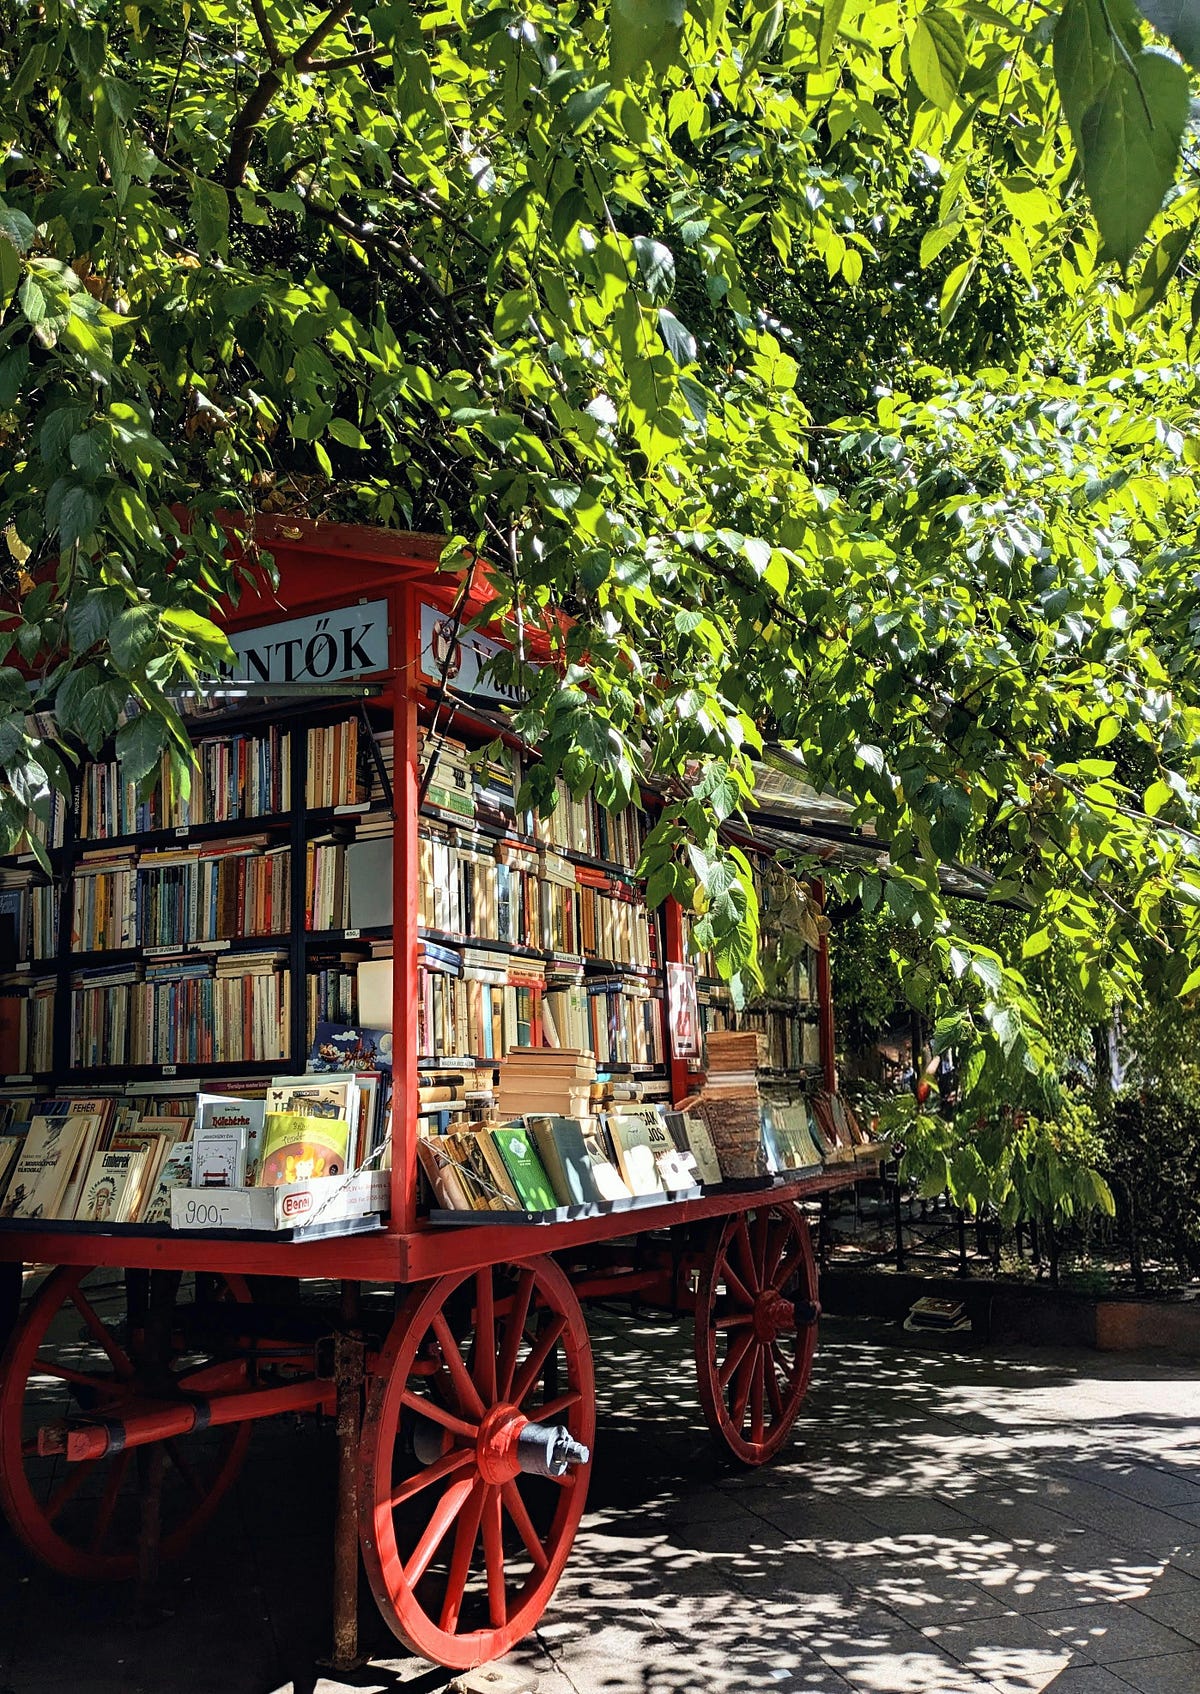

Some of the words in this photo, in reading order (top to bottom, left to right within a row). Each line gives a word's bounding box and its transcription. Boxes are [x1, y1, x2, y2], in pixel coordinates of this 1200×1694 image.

[215, 617, 377, 683] ENTŐK
[72, 1102, 96, 1113] FEHÉR
[185, 1200, 230, 1225] 900,-
